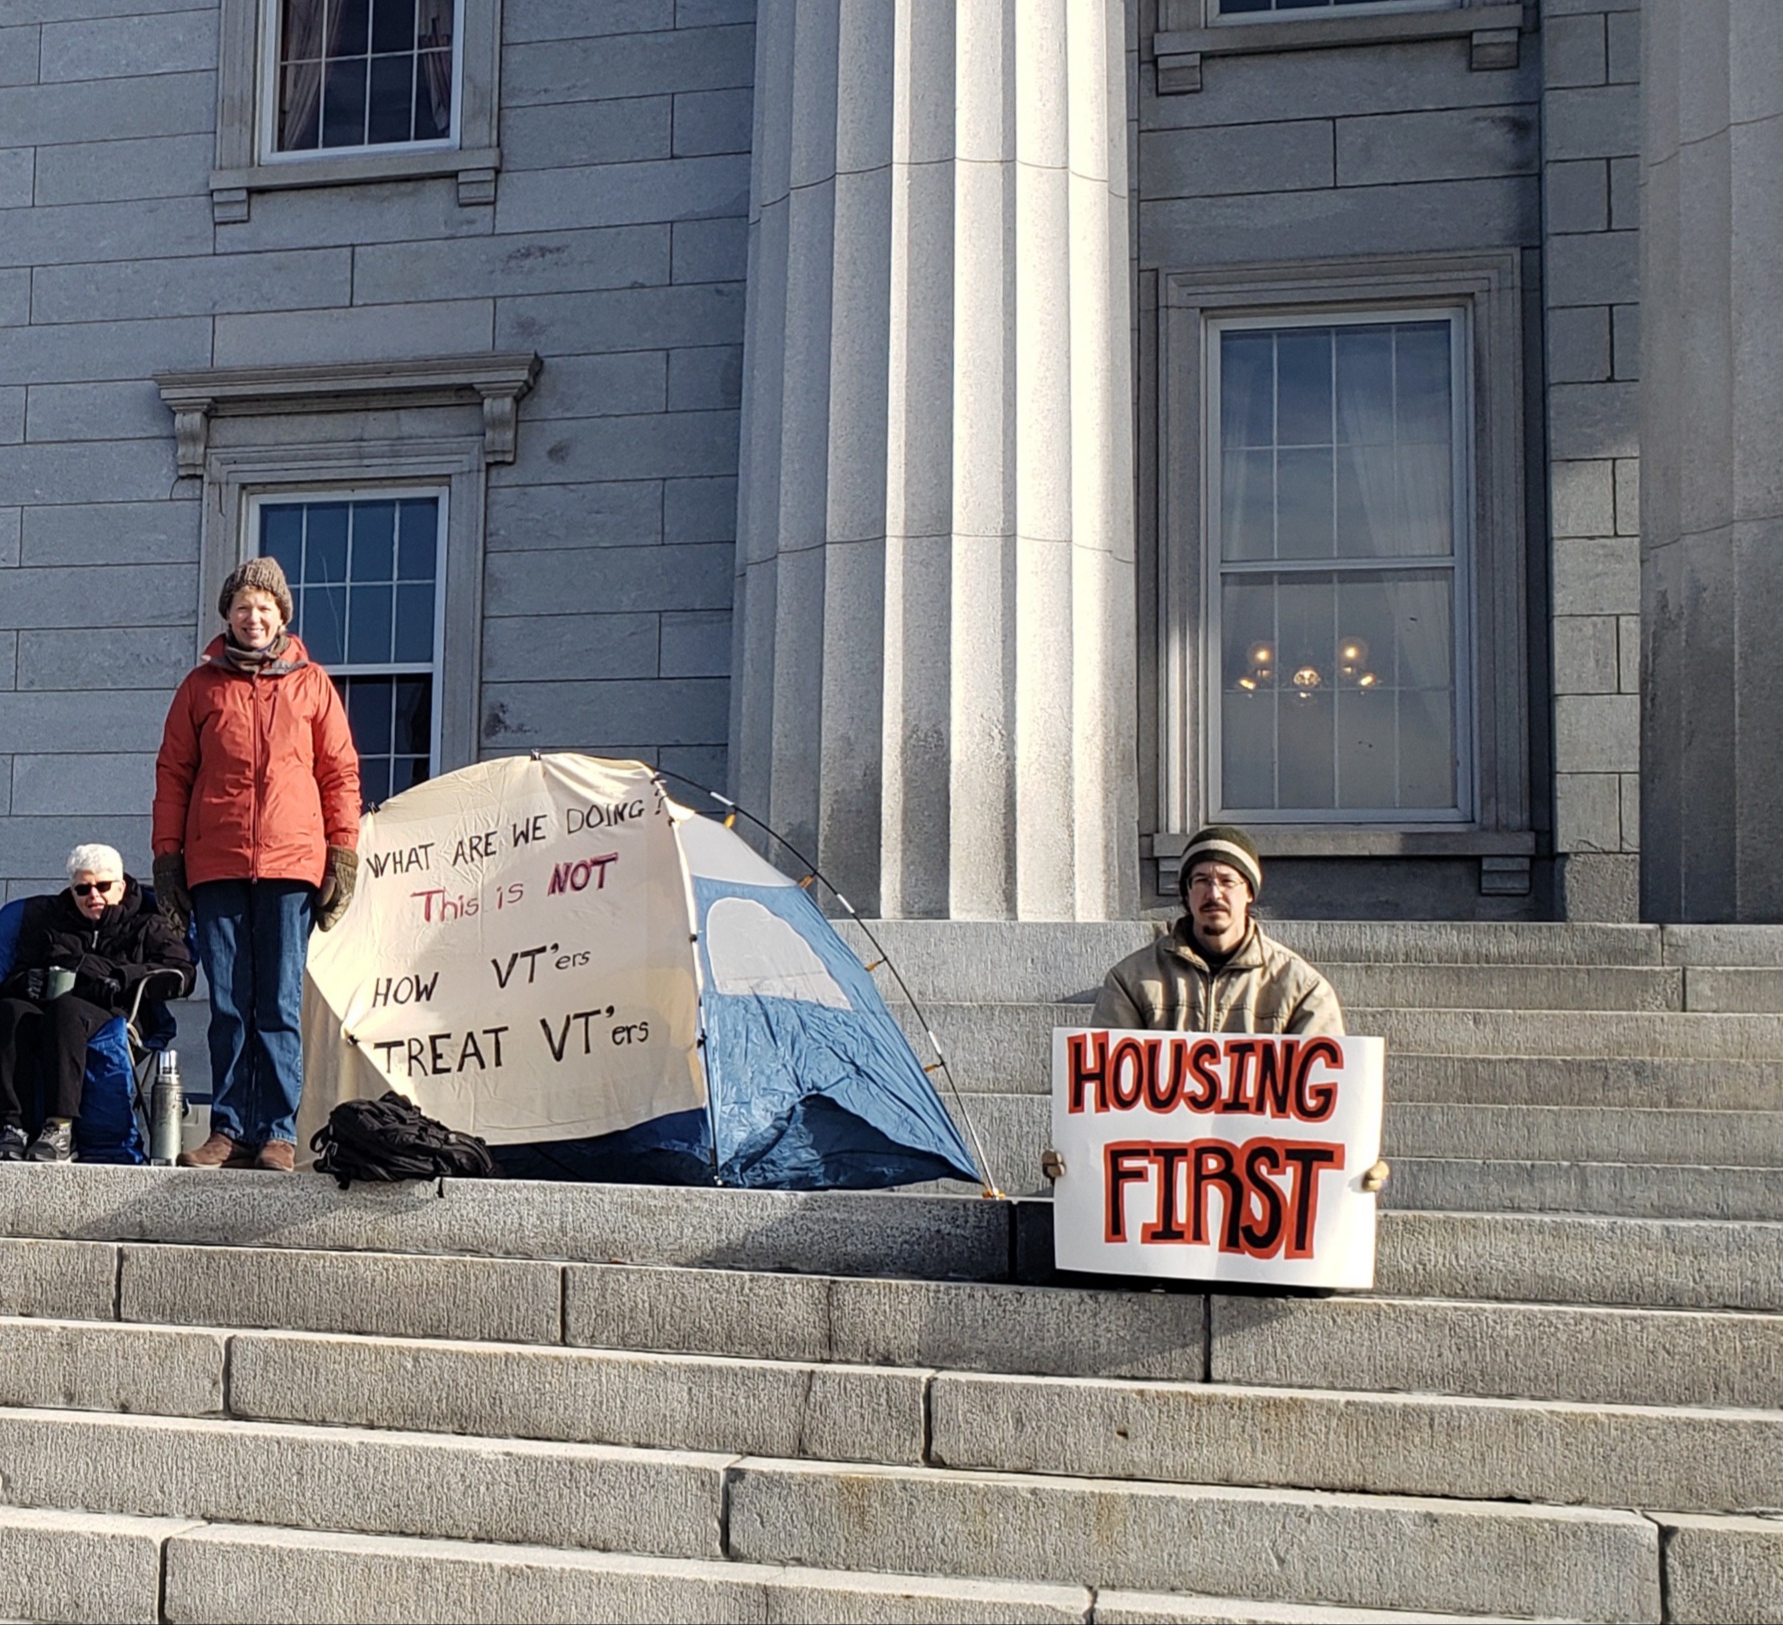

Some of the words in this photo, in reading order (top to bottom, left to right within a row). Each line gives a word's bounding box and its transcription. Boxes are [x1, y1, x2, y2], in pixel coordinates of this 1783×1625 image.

[367, 842, 435, 879] WHAT
[452, 831, 498, 867] ARE
[512, 814, 548, 848] WE
[410, 884, 480, 922] This
[496, 882, 524, 911] is
[547, 851, 619, 897] NOT
[372, 971, 439, 1008] HOW
[373, 1026, 509, 1077] TREAT
[1067, 1031, 1344, 1123] HOUSING
[1103, 1136, 1345, 1260] FIRST
